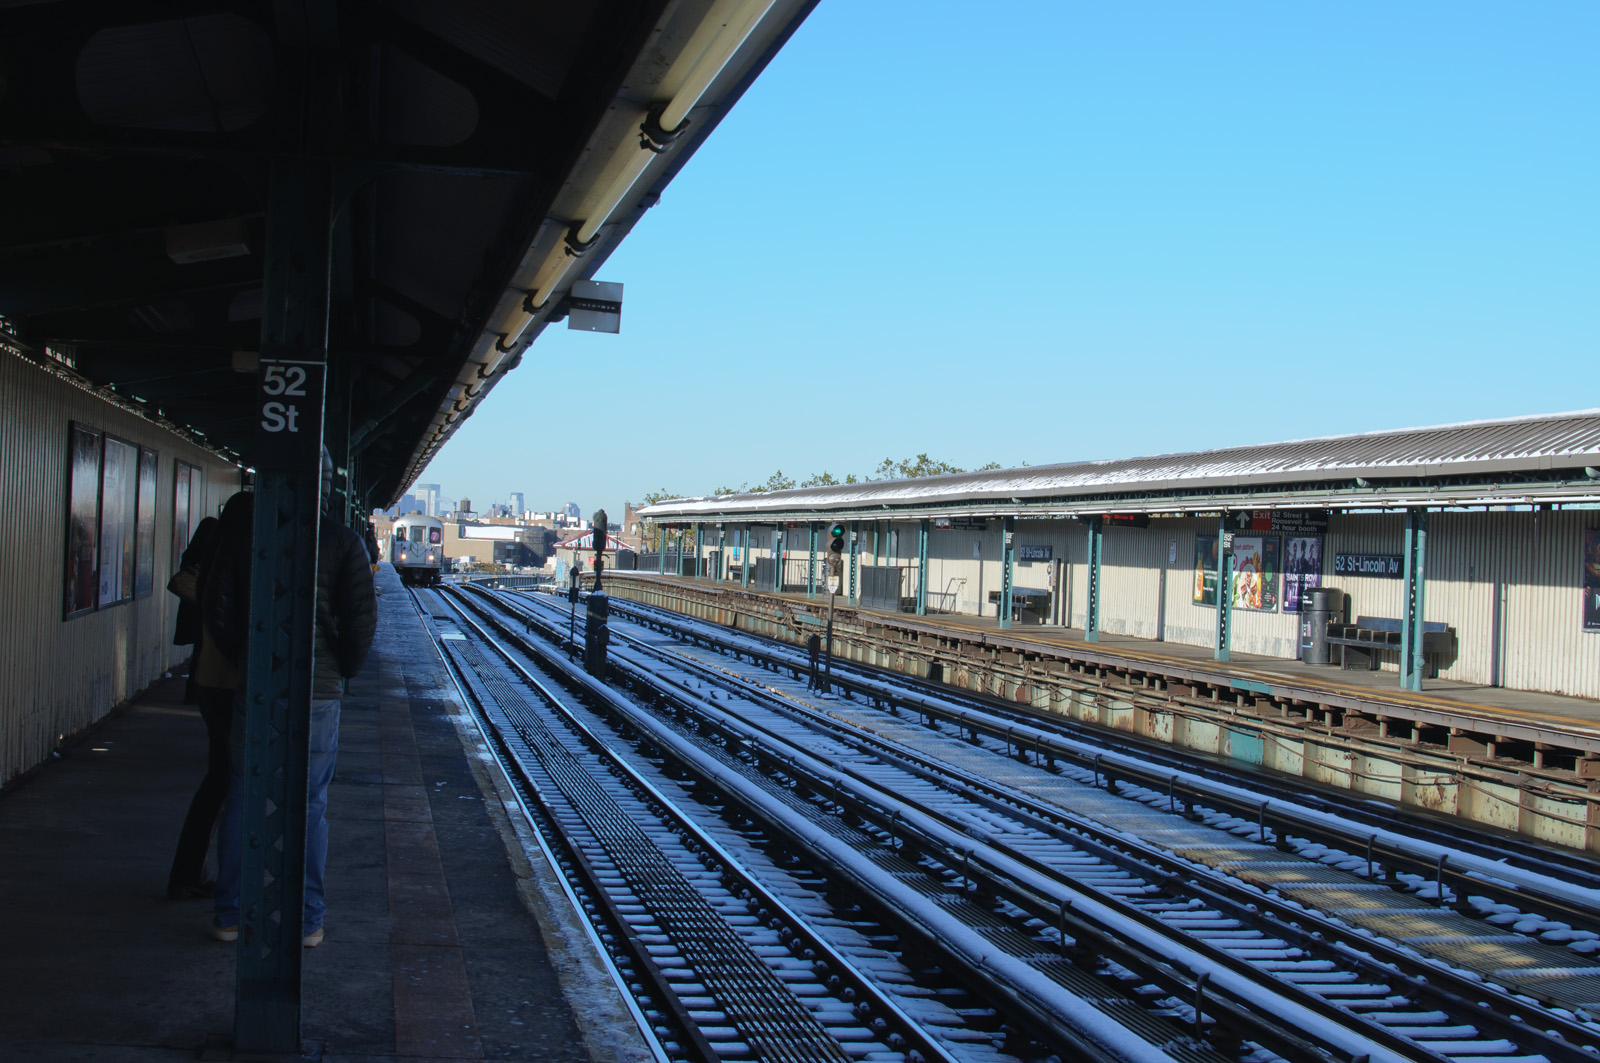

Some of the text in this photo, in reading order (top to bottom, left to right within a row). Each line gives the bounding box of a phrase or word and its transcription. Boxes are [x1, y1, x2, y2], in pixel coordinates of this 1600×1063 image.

[262, 366, 306, 396] 52
[261, 401, 299, 432] St
[1252, 510, 1271, 519] Exit
[1283, 511, 1302, 519] Street
[1335, 556, 1399, 573] 52 St-Lincoln Av
[1286, 573, 1317, 581] SAINTS ROW
